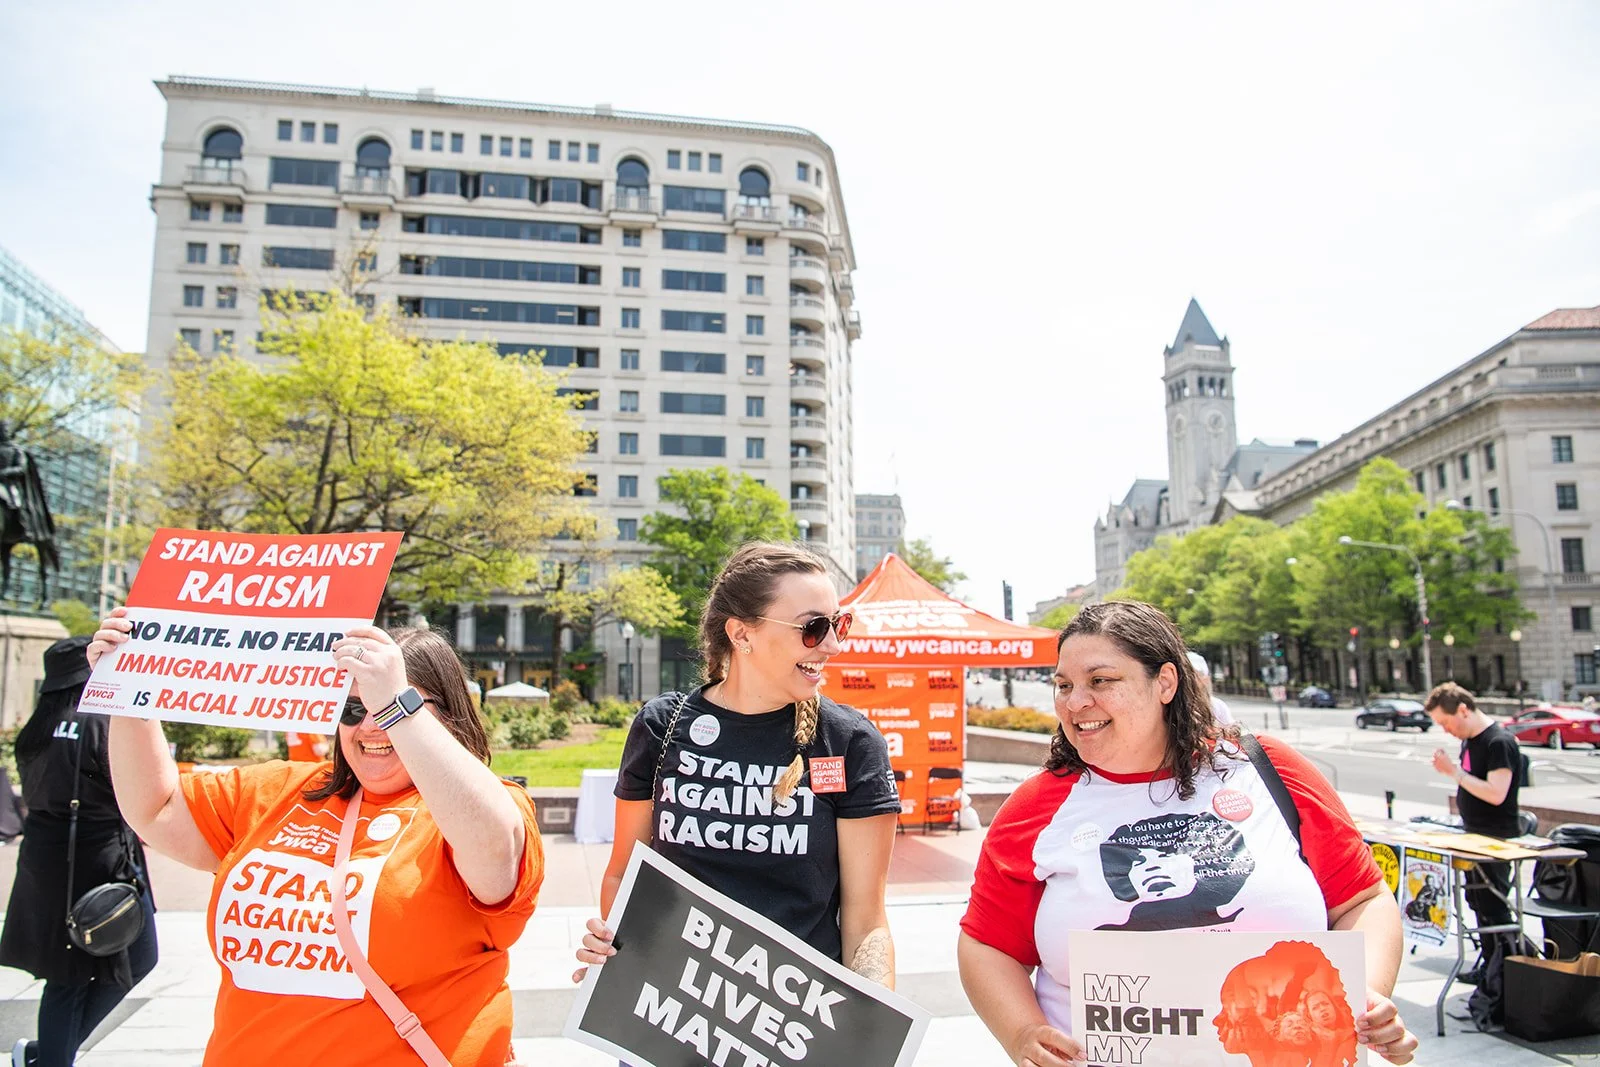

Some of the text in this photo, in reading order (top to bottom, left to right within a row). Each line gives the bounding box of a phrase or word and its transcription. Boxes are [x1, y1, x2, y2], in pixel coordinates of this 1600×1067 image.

[160, 538, 385, 567] STAND AGAINST
[177, 570, 330, 608] RACISM
[126, 620, 161, 641] NO
[164, 624, 231, 649] HATE.
[237, 630, 278, 651] NO
[859, 613, 969, 631] ywca
[839, 639, 1034, 659] www.ywcanca.org
[115, 653, 348, 689] IMMIGRANT JUSTICE
[85, 689, 115, 700] ywca
[132, 688, 338, 723] IS RACIAL JUSTICE
[812, 761, 842, 770] STAND
[813, 769, 843, 777] AGAINST
[813, 776, 843, 785] RACISM
[661, 777, 816, 817] AGAINST
[1215, 792, 1245, 804] STAND
[1221, 804, 1252, 815] RACISM
[658, 810, 809, 855] RACISM
[1118, 834, 1152, 845] though
[1127, 823, 1147, 832] You
[1148, 821, 1173, 831] have
[1174, 819, 1186, 827] to
[268, 831, 330, 855] ywca
[1194, 870, 1205, 879] all
[1207, 868, 1225, 877] the
[222, 936, 353, 973] RACISM
[681, 905, 847, 1031] BLACK
[1083, 973, 1151, 1003] MY
[678, 957, 815, 1061] LIVES
[1085, 1004, 1204, 1036] RIGHT
[633, 981, 781, 1067] MATT
[1086, 1034, 1152, 1064] MY
